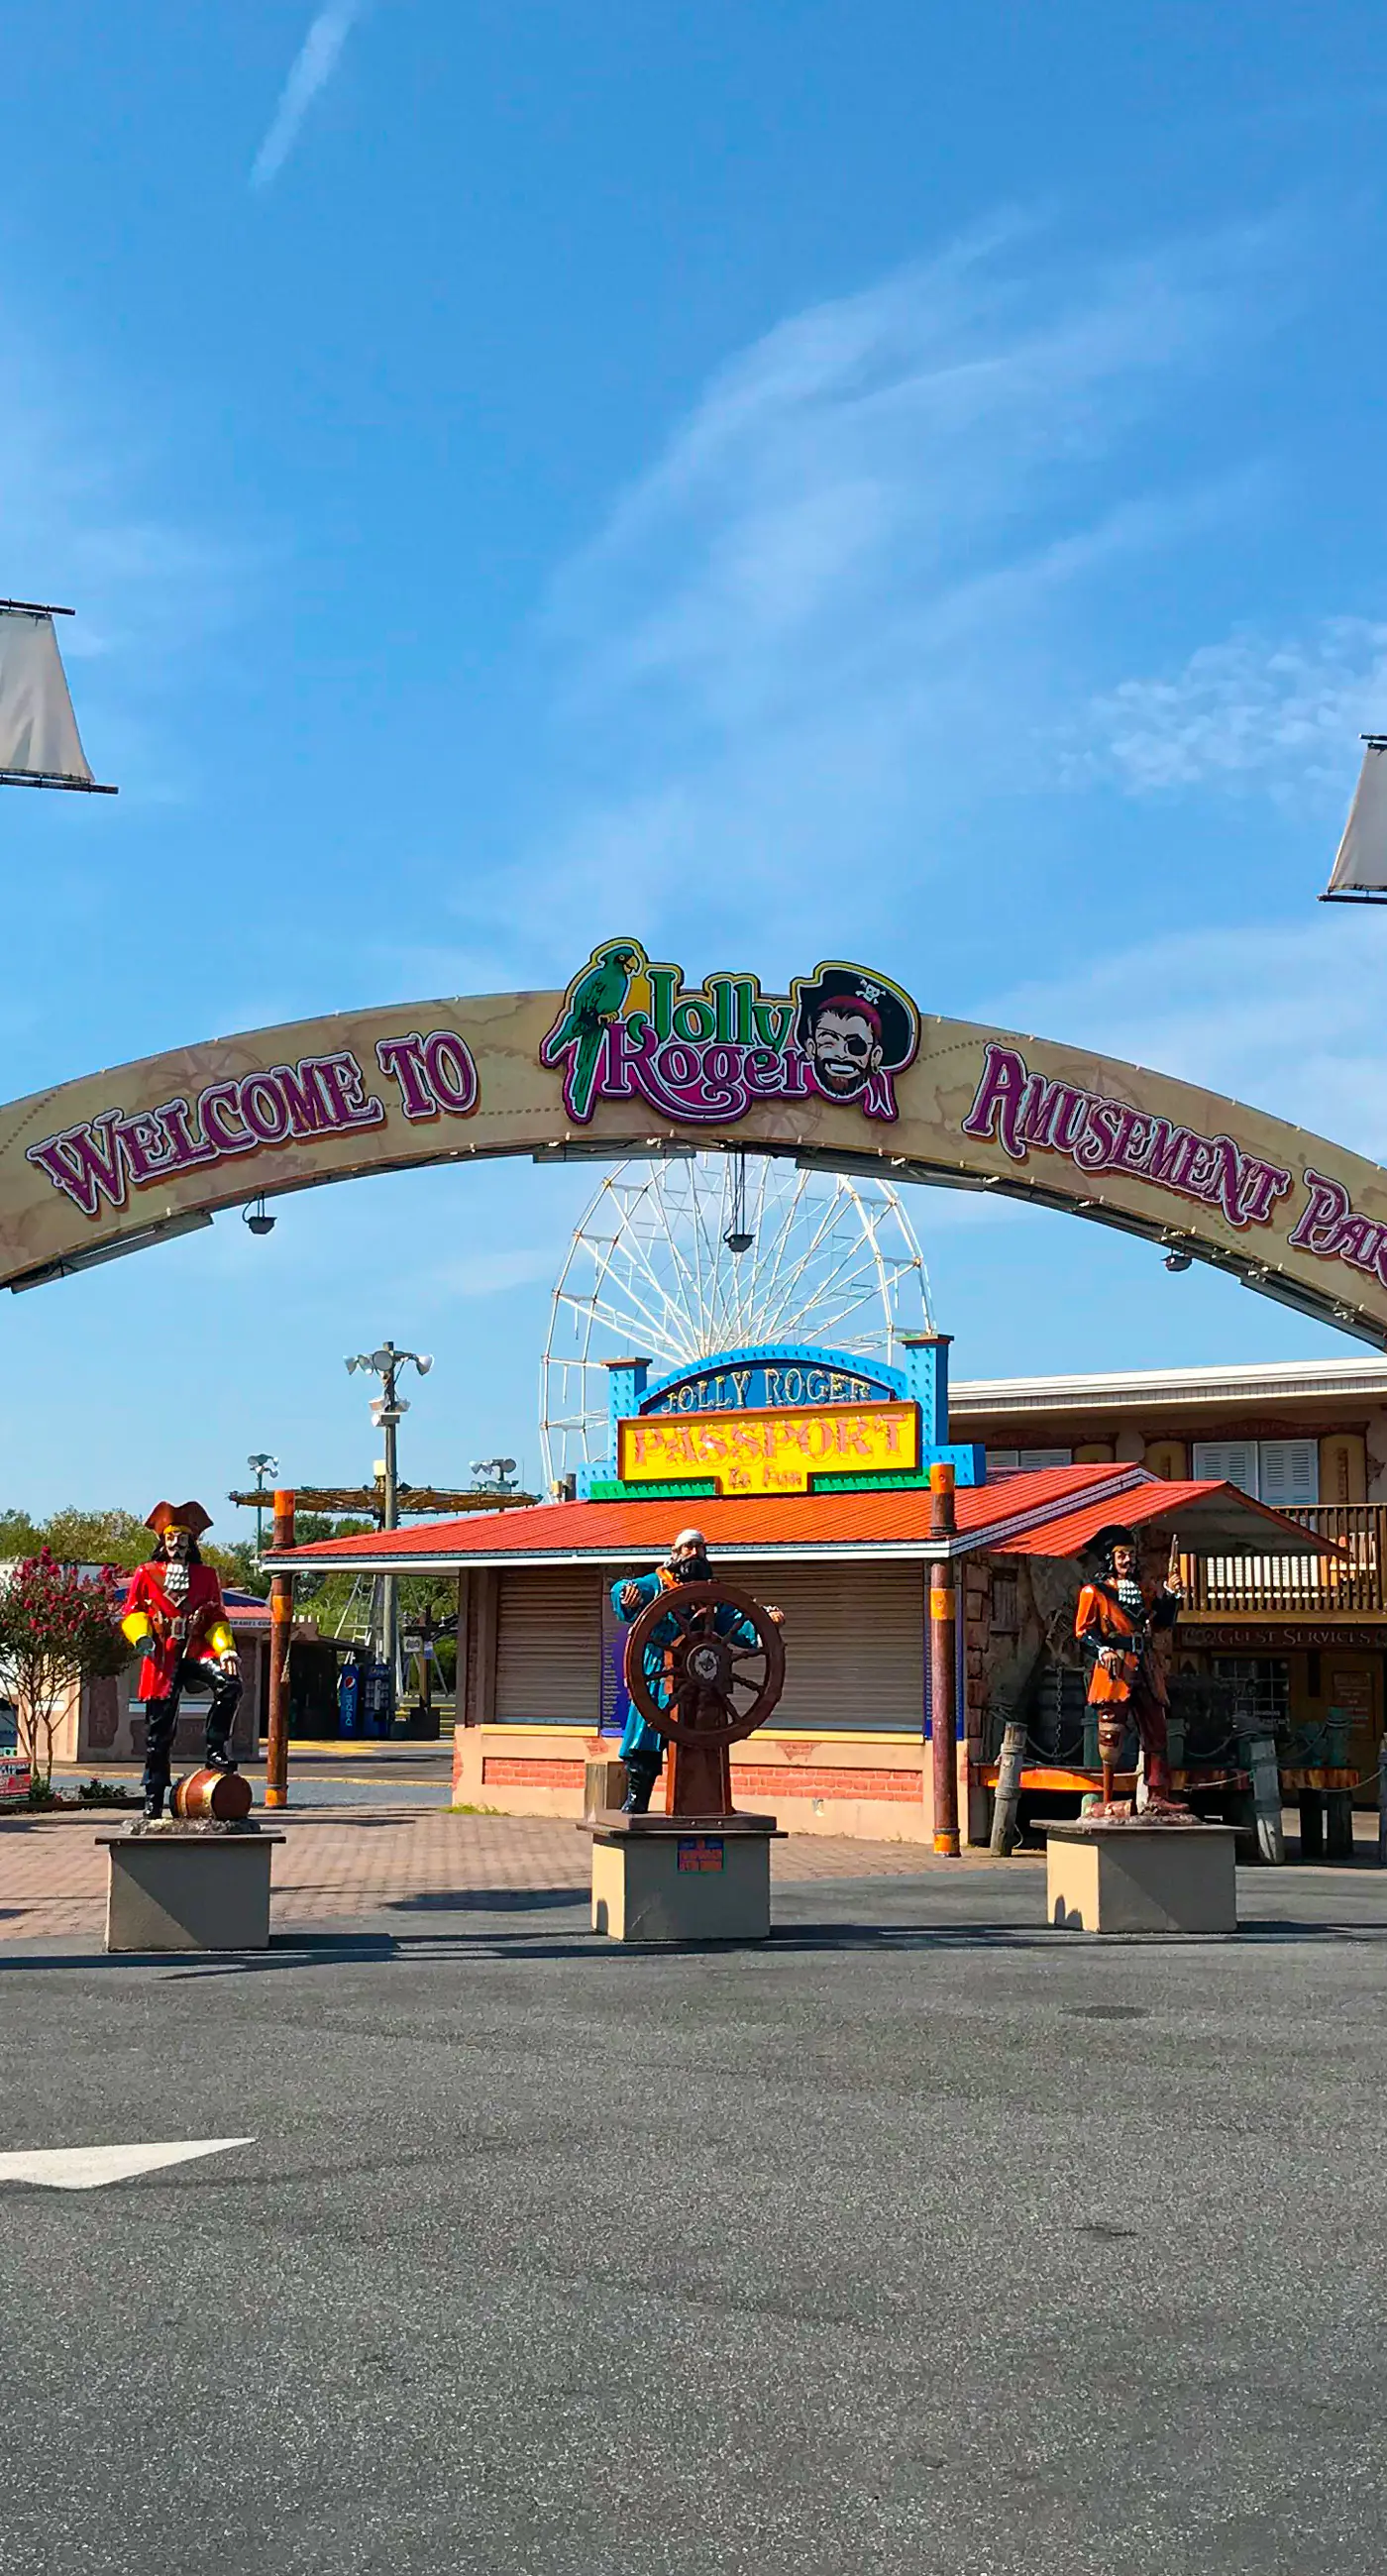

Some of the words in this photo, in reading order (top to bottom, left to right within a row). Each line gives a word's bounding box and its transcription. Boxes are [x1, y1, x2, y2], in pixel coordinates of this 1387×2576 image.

[625, 970, 795, 1053] Jolly
[602, 1022, 814, 1118] Roger
[28, 1052, 383, 1214] WELCOME
[377, 1031, 478, 1118] TO
[964, 1043, 1290, 1225] AMUSEMENT
[661, 1368, 752, 1414] JOLLY
[763, 1368, 872, 1405] ROGER
[632, 1413, 908, 1467] PASSPORT
